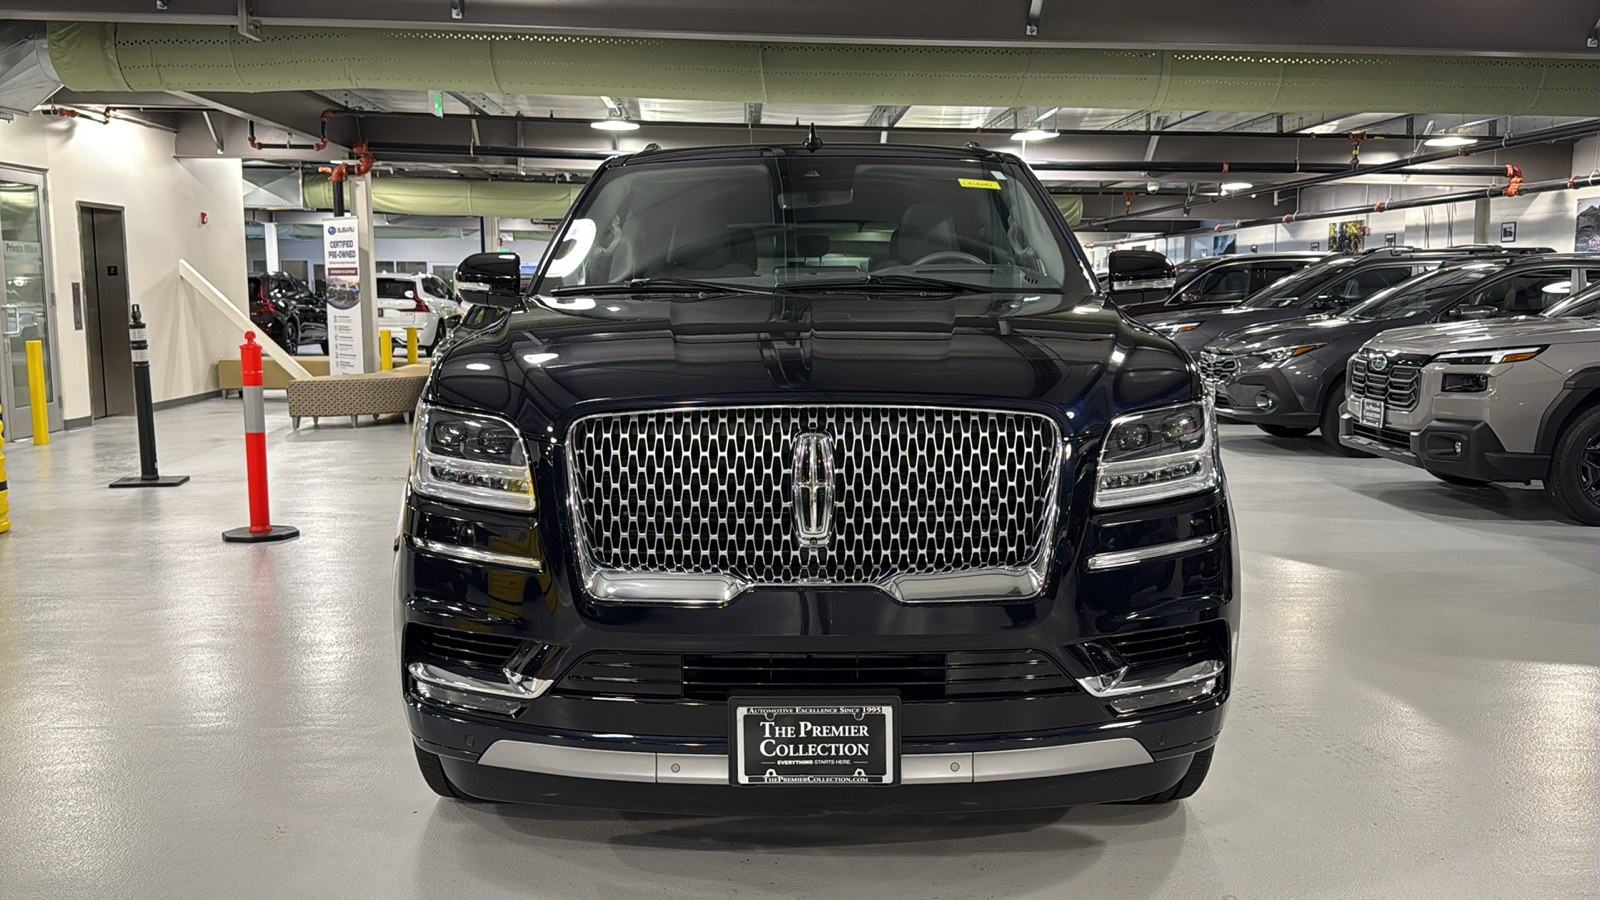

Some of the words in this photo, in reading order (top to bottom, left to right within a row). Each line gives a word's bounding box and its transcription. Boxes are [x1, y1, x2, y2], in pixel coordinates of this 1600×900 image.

[6, 243, 24, 253] Private
[330, 240, 354, 249] CERTIFIED
[328, 250, 357, 259] PRE-OWNED
[760, 722, 796, 738] THE
[799, 722, 870, 737] PREMIER
[760, 739, 870, 756] COLLECTION
